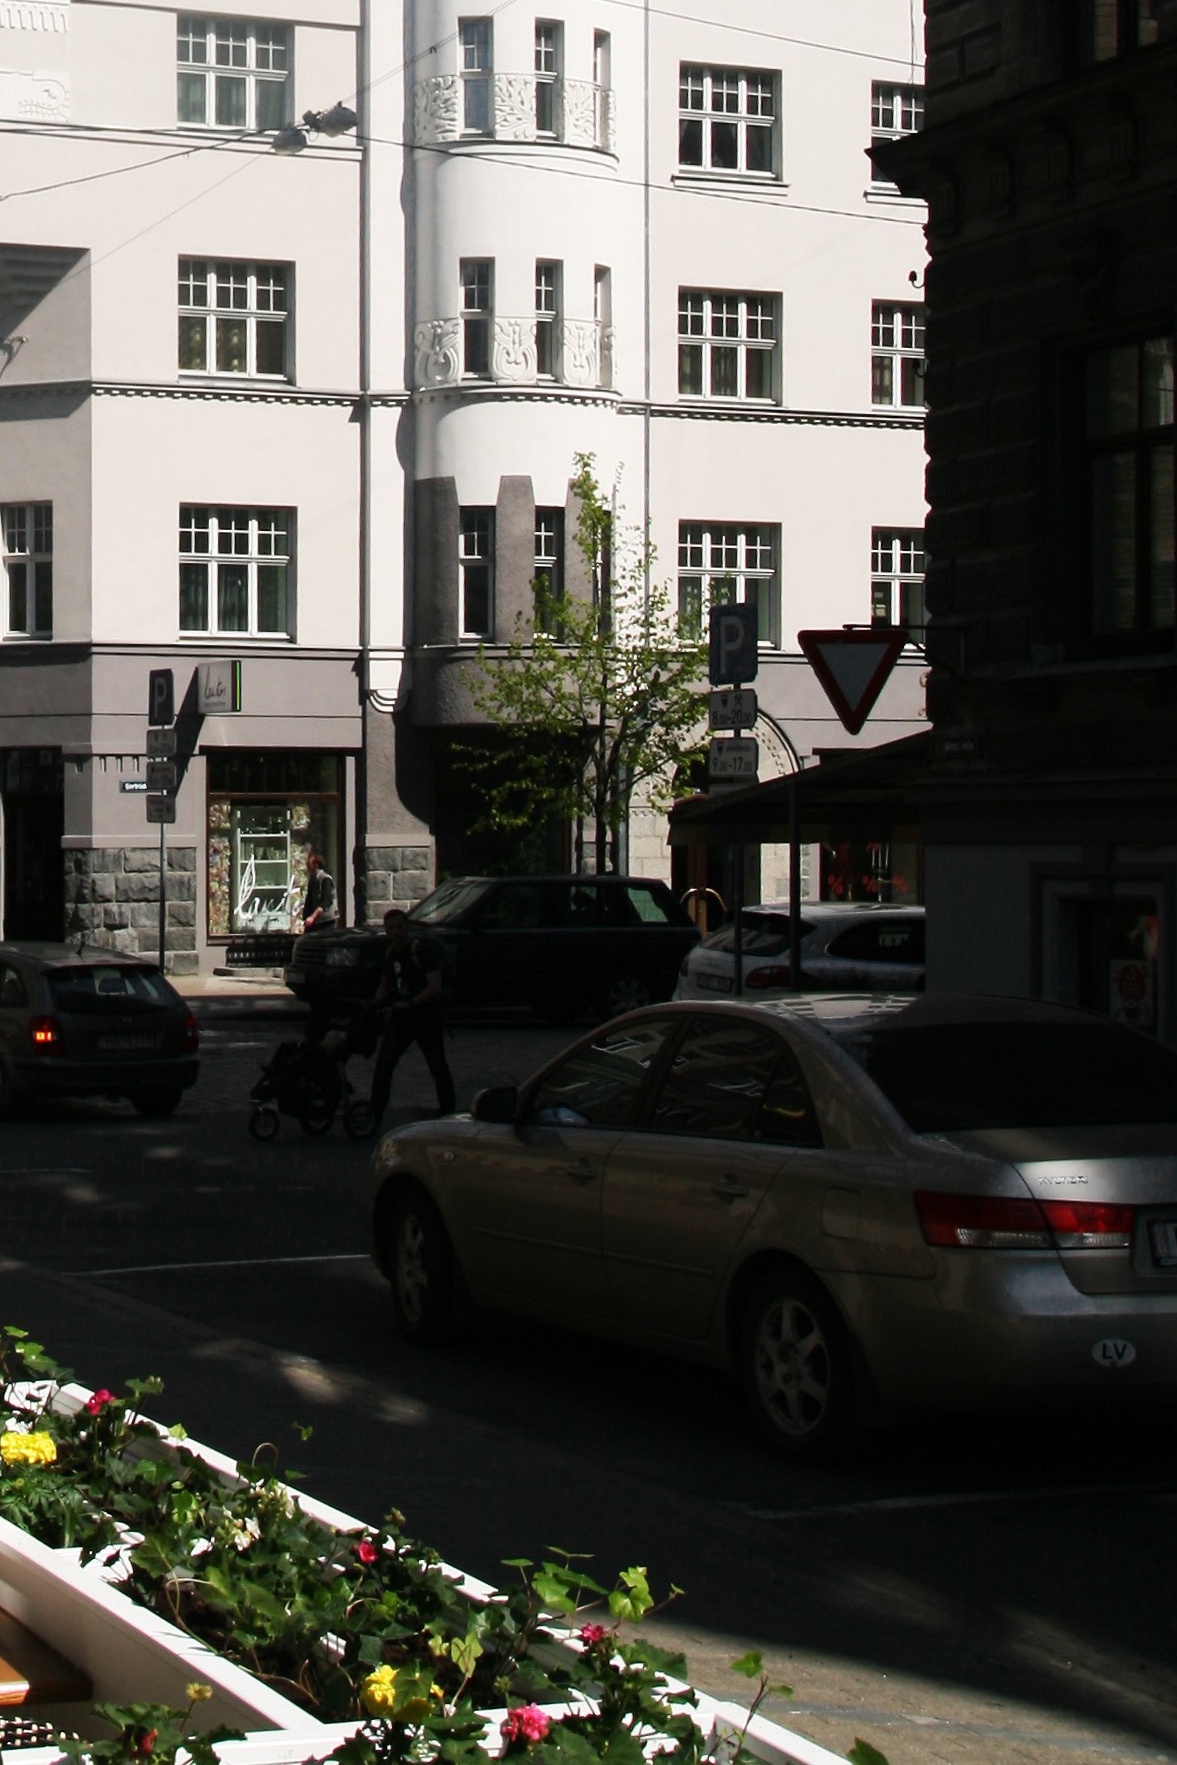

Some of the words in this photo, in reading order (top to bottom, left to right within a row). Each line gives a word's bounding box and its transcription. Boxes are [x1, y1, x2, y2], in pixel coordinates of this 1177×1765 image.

[719, 614, 745, 675] P
[154, 676, 167, 718] P
[1101, 1342, 1128, 1360] LV
